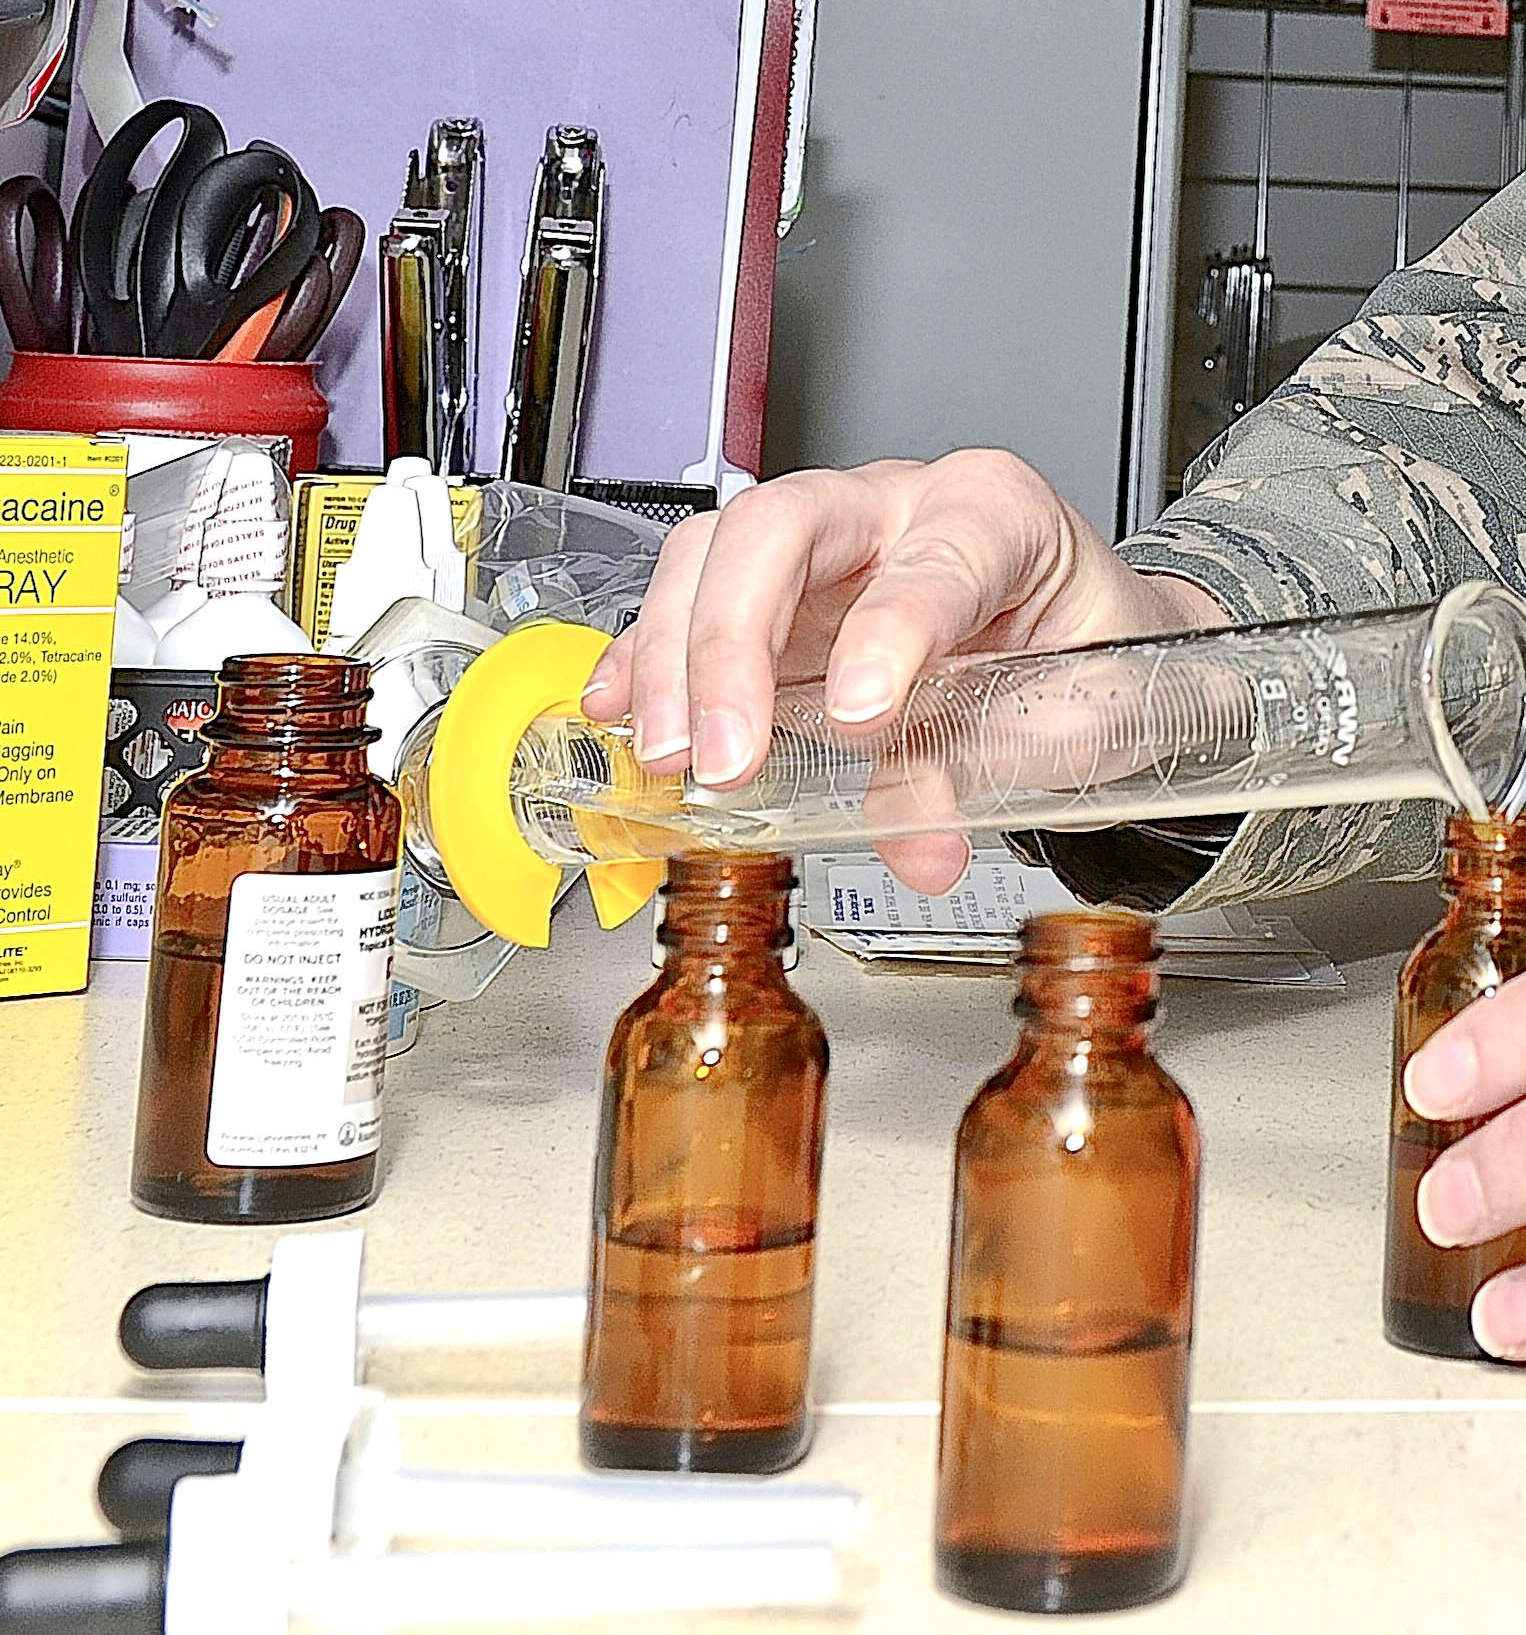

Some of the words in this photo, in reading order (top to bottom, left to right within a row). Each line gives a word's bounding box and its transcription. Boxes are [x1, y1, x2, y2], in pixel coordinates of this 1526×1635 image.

[0, 492, 104, 522] acaine
[325, 516, 356, 532] Drug
[13, 632, 57, 646] 14.0%,
[41, 650, 102, 663] Tetracaine
[20, 670, 58, 685] 2.0%)
[0, 743, 54, 762] agging
[37, 768, 57, 781] on
[110, 892, 147, 903] sulfuric
[112, 903, 122, 915] to
[244, 953, 263, 965] DO
[267, 953, 295, 965] NOT
[298, 952, 342, 965] INJECT
